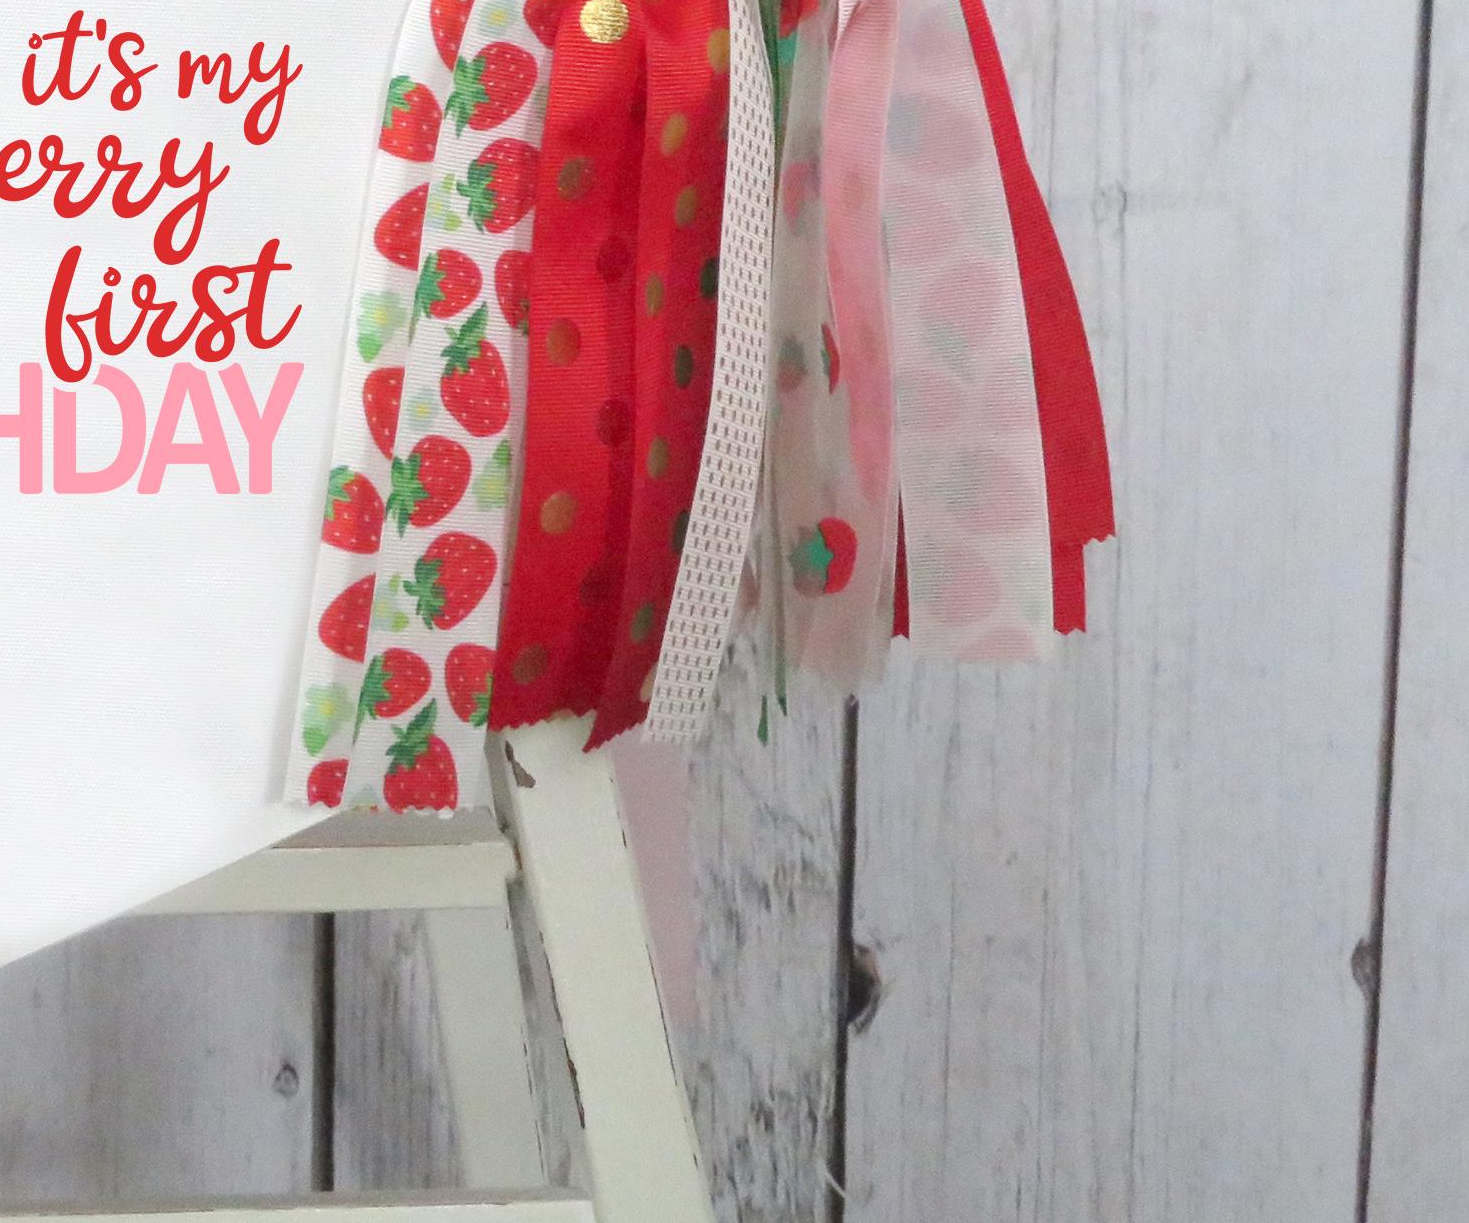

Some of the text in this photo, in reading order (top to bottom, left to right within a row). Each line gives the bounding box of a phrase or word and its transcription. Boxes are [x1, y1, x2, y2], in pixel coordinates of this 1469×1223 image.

[21, 9, 304, 147] it's my
[44, 237, 303, 384] first
